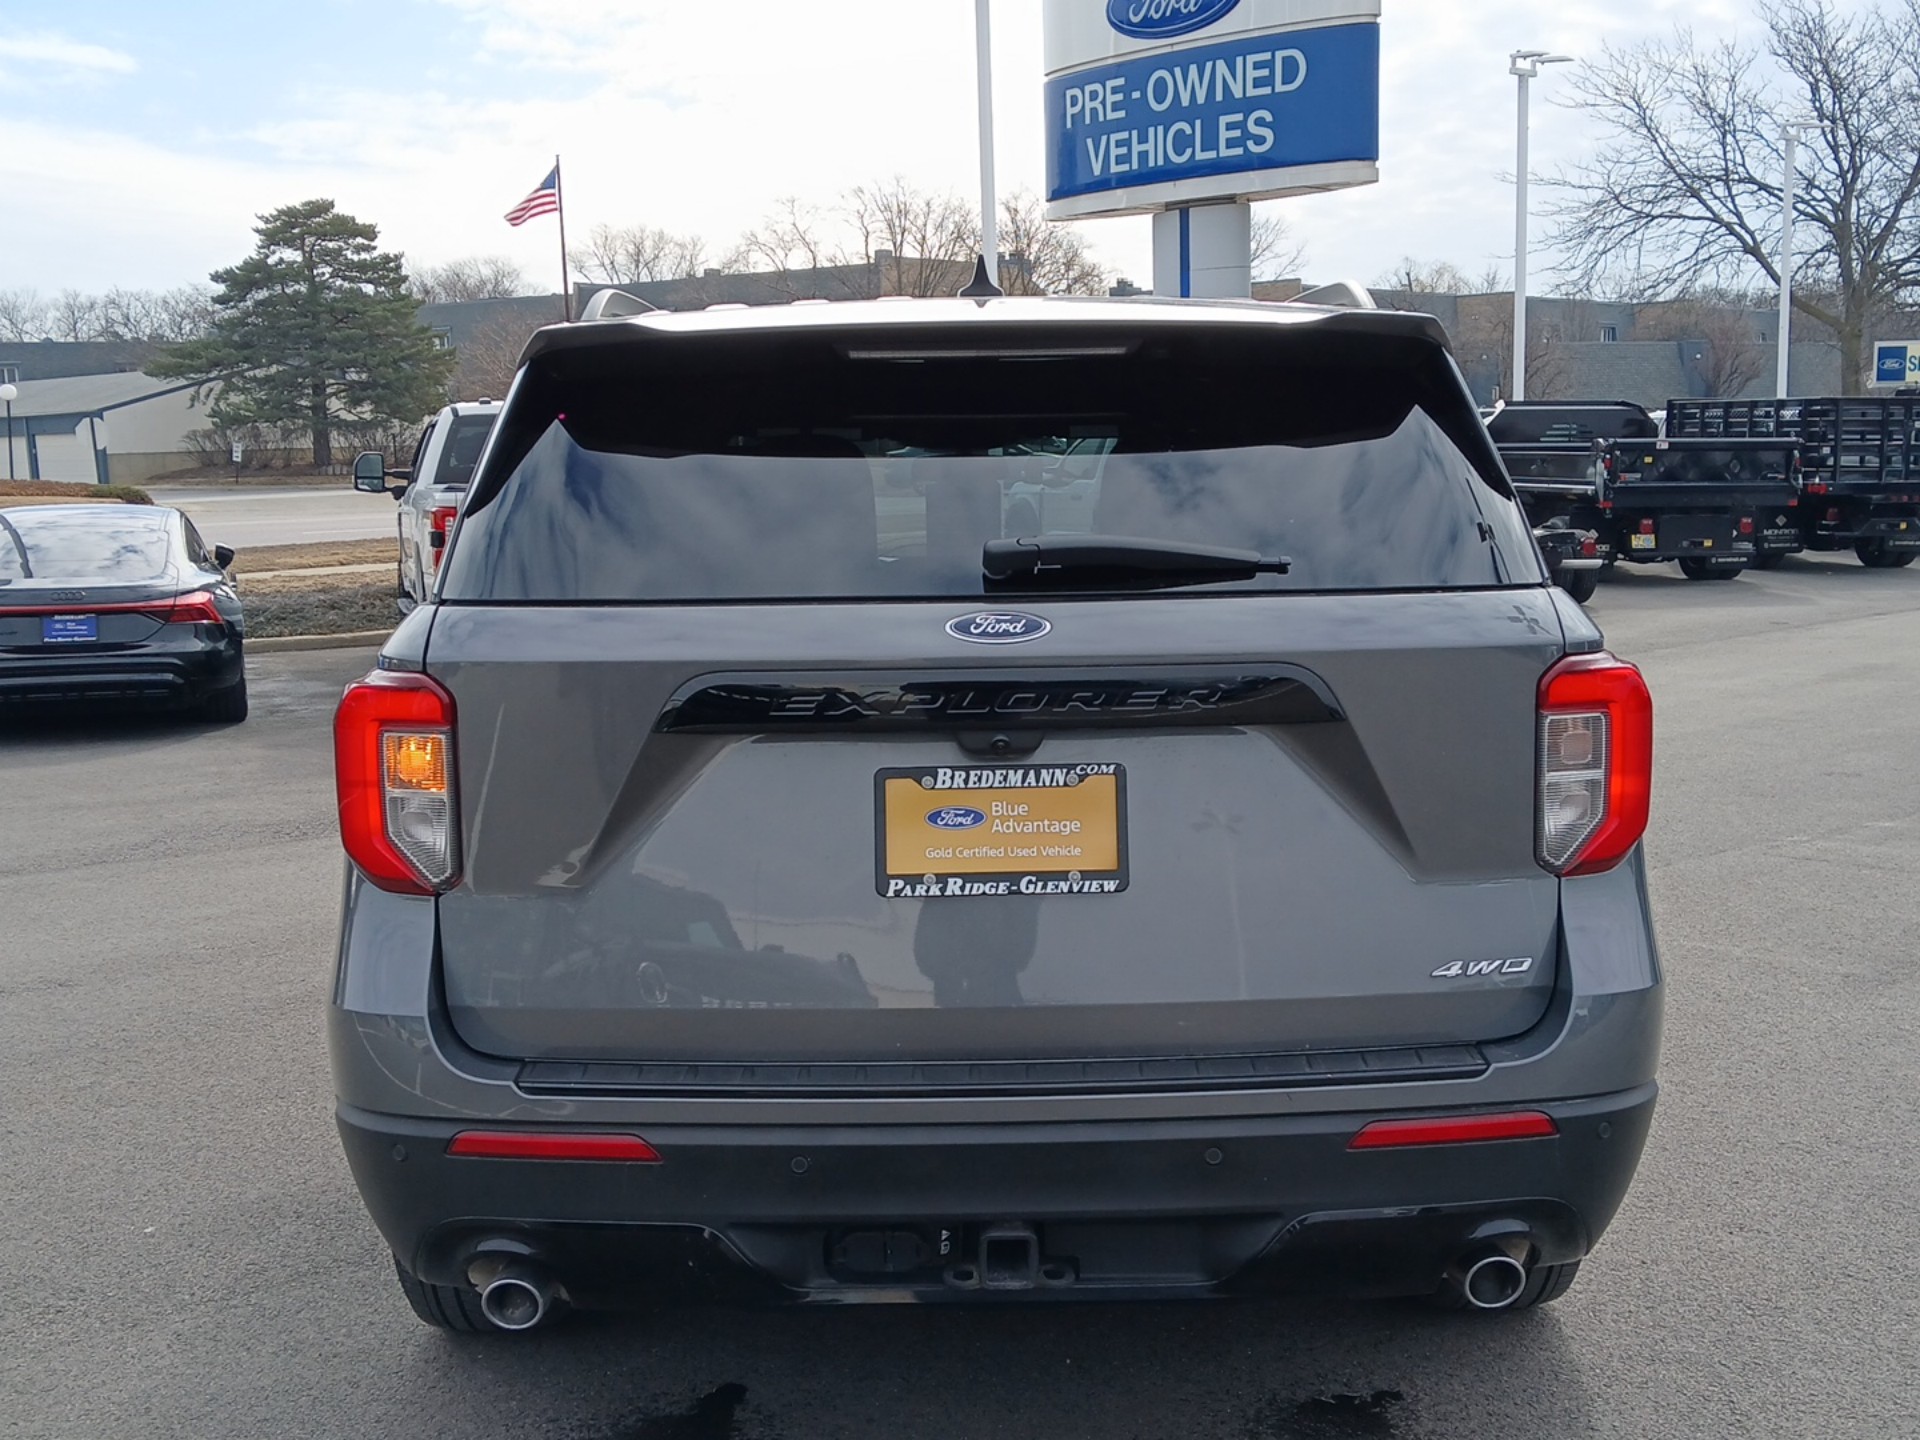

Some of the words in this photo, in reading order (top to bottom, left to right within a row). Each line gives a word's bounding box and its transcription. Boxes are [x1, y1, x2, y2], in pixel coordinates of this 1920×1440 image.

[1066, 48, 1308, 129] PRE-OWNED
[1087, 109, 1275, 176] VEHICLES
[1908, 355, 1920, 372] S
[970, 615, 1026, 634] Ford
[768, 691, 1223, 716] EXPLORER
[936, 808, 976, 826] Ford
[991, 801, 1029, 816] Blue
[991, 818, 1081, 835] Advantage
[925, 847, 953, 858] Gold
[956, 846, 1005, 858] Certified
[1008, 846, 1037, 857] Used
[1042, 845, 1082, 857] Vehicle
[886, 879, 944, 898] PARK
[1431, 957, 1533, 977] 4WD
